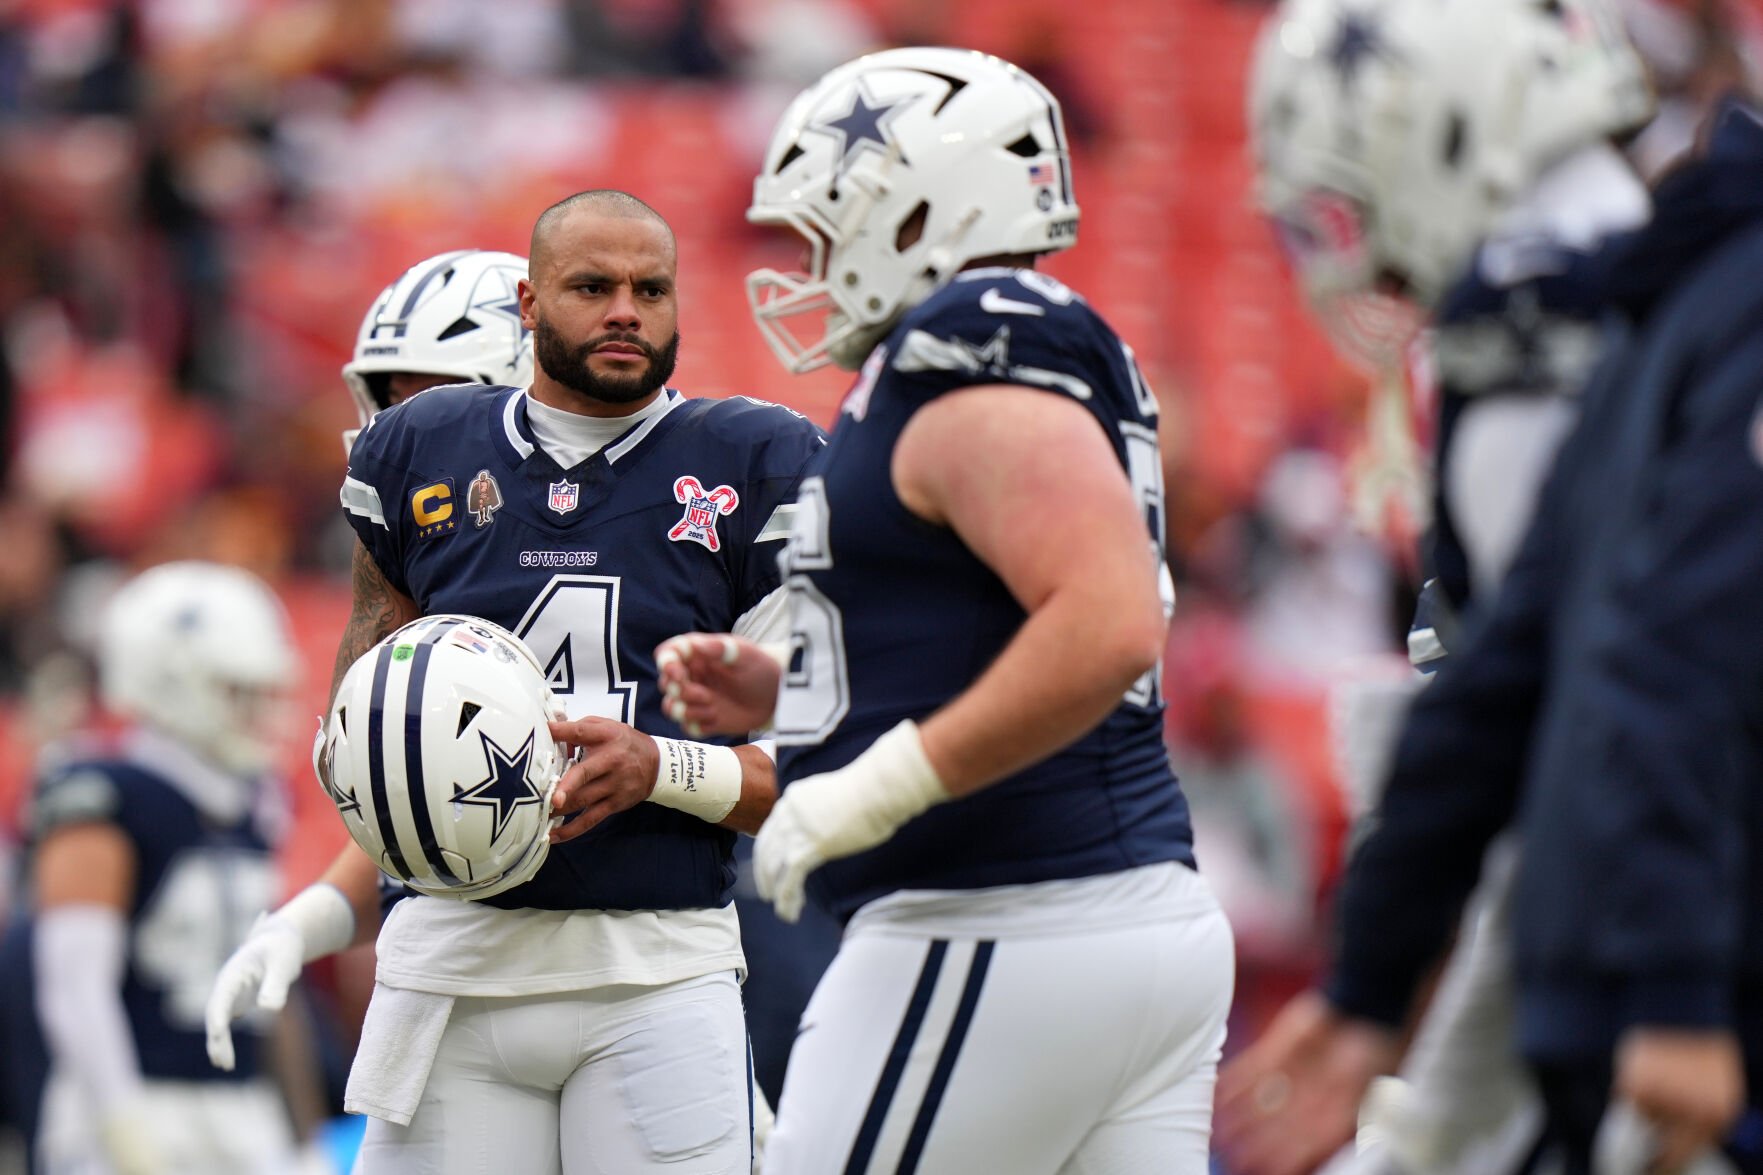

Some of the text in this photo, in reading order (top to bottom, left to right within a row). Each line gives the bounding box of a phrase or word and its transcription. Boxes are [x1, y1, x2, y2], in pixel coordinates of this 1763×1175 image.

[412, 483, 453, 527] C
[553, 495, 573, 509] NFL
[689, 508, 711, 526] NFL
[688, 531, 704, 540] 2025
[520, 551, 598, 567] COWBOYS
[512, 573, 638, 728] 4
